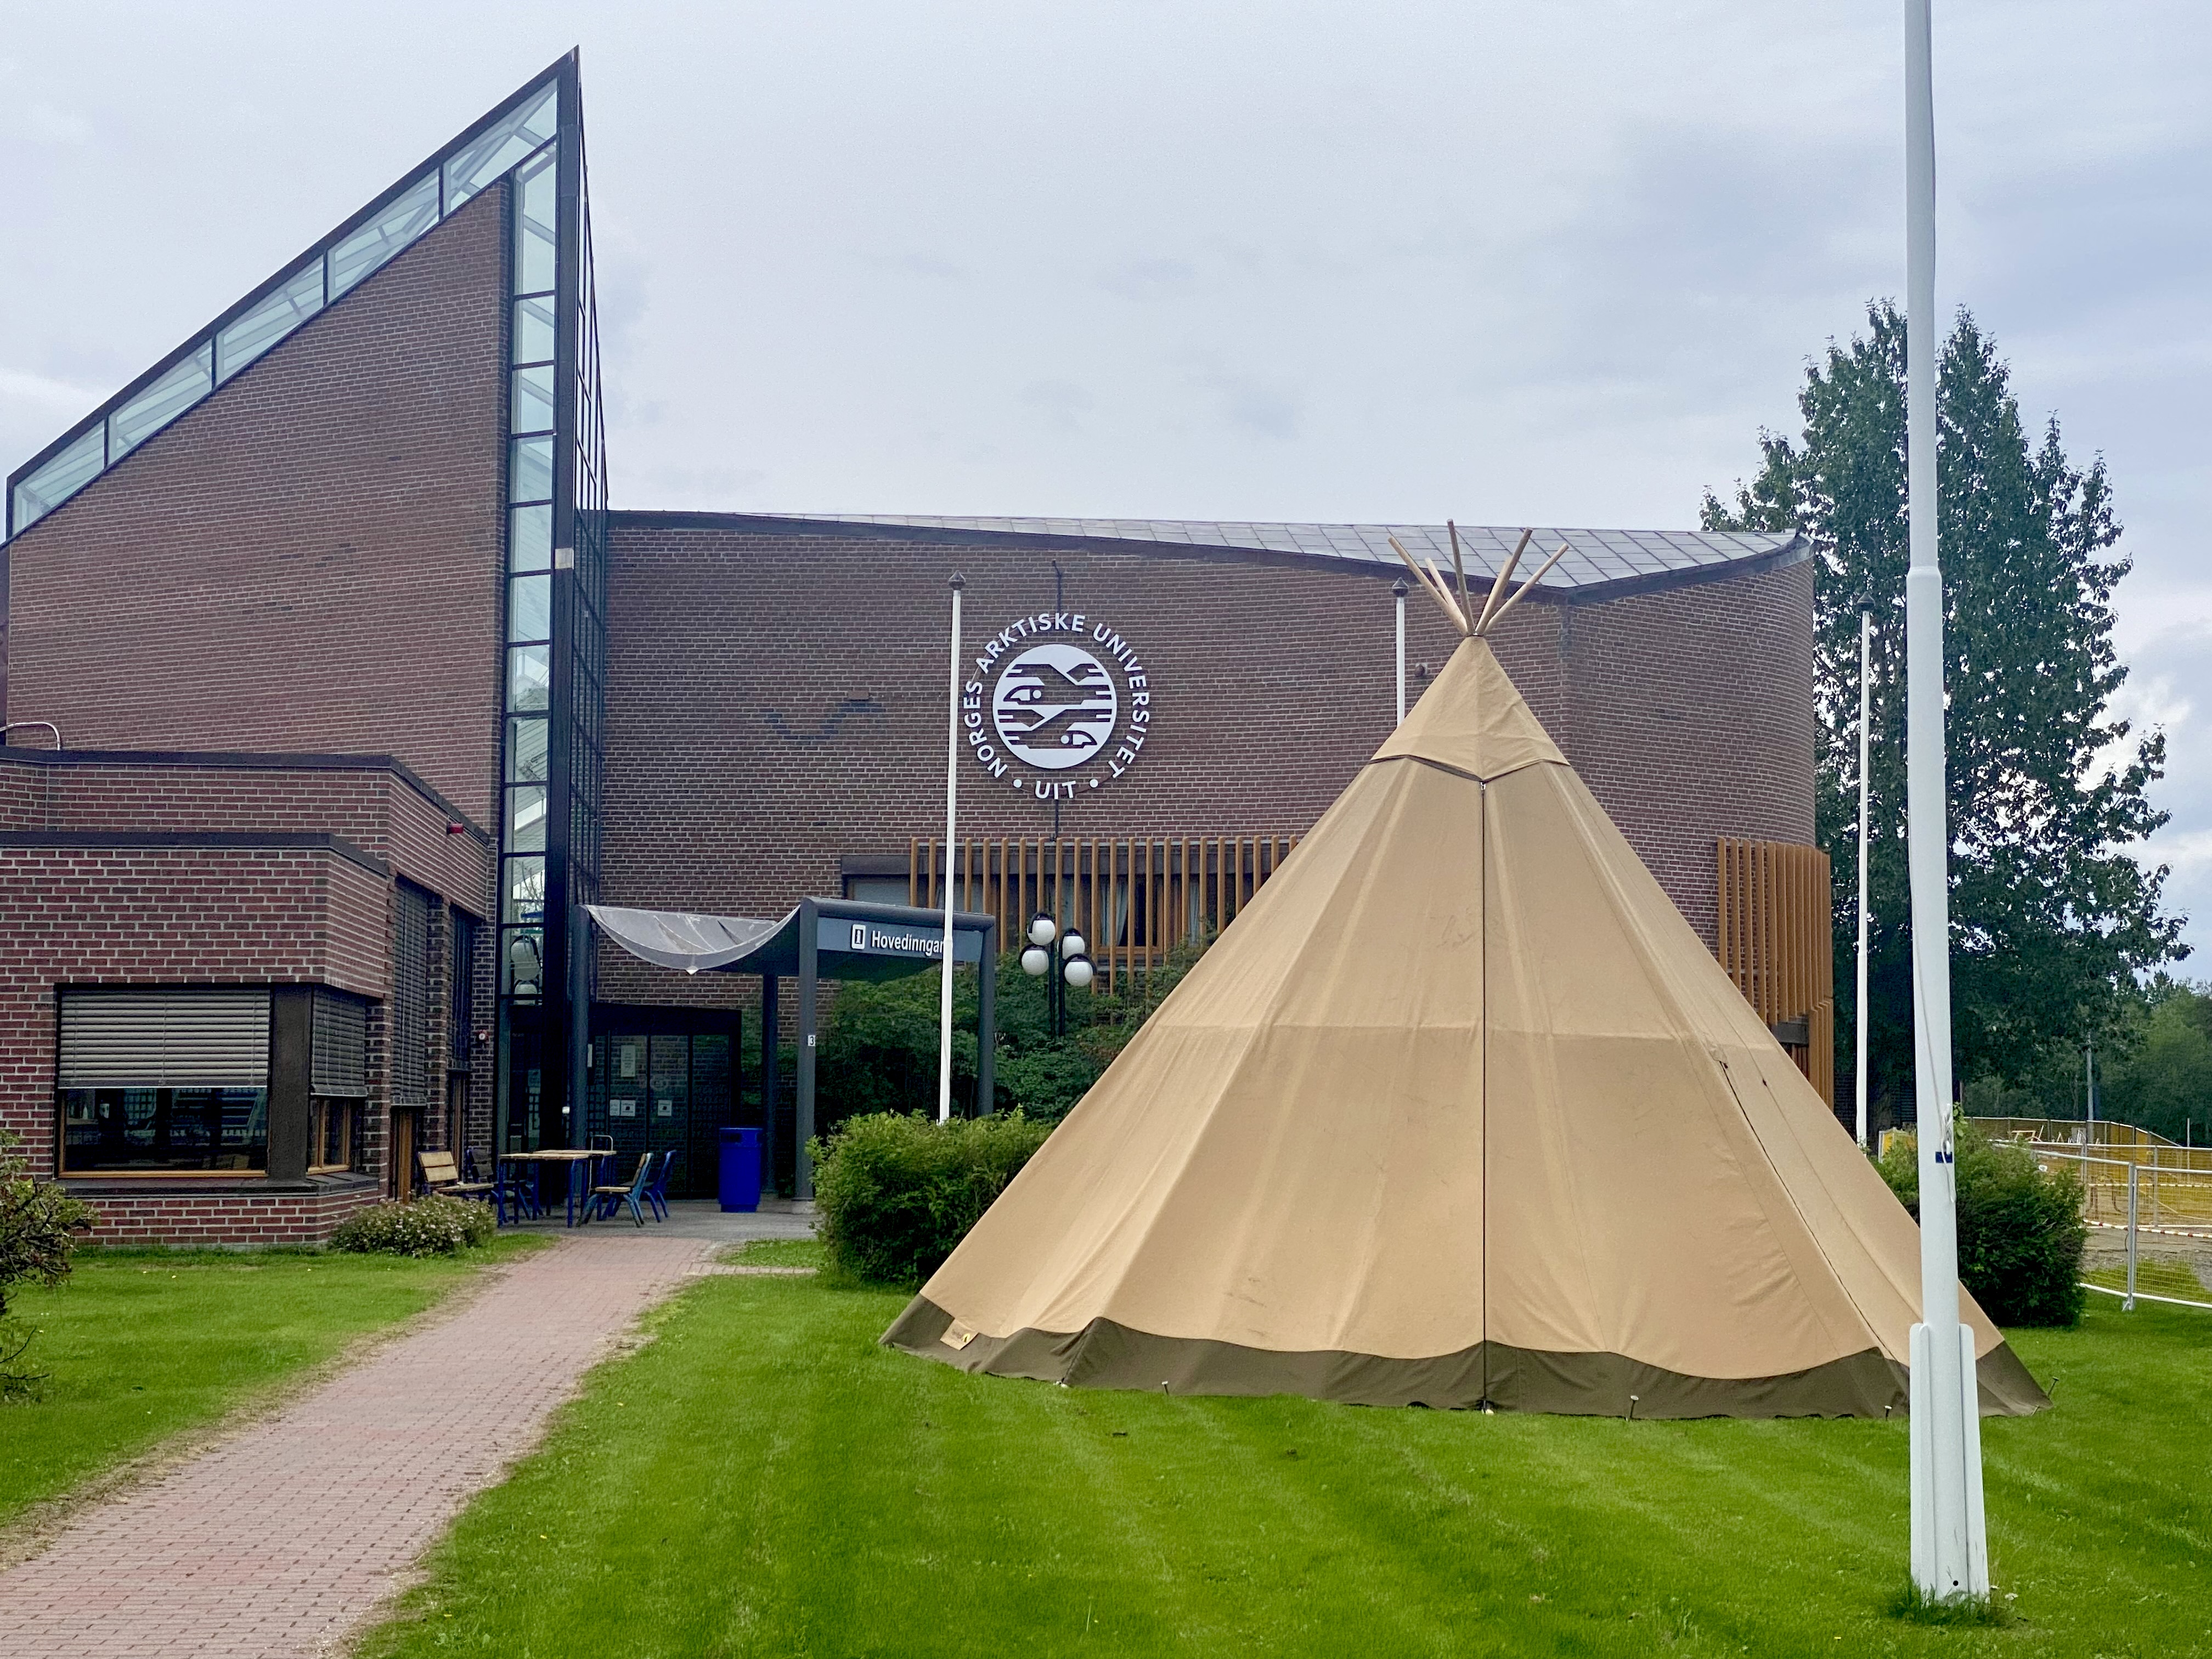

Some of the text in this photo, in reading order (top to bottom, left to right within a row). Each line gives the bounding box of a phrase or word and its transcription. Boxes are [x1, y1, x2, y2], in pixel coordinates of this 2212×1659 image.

[963, 612, 1150, 778] NORGES ARKTISKE UNIVERSITET
[1035, 780, 1076, 799] UIT
[871, 930, 943, 957] Hovedinnga
